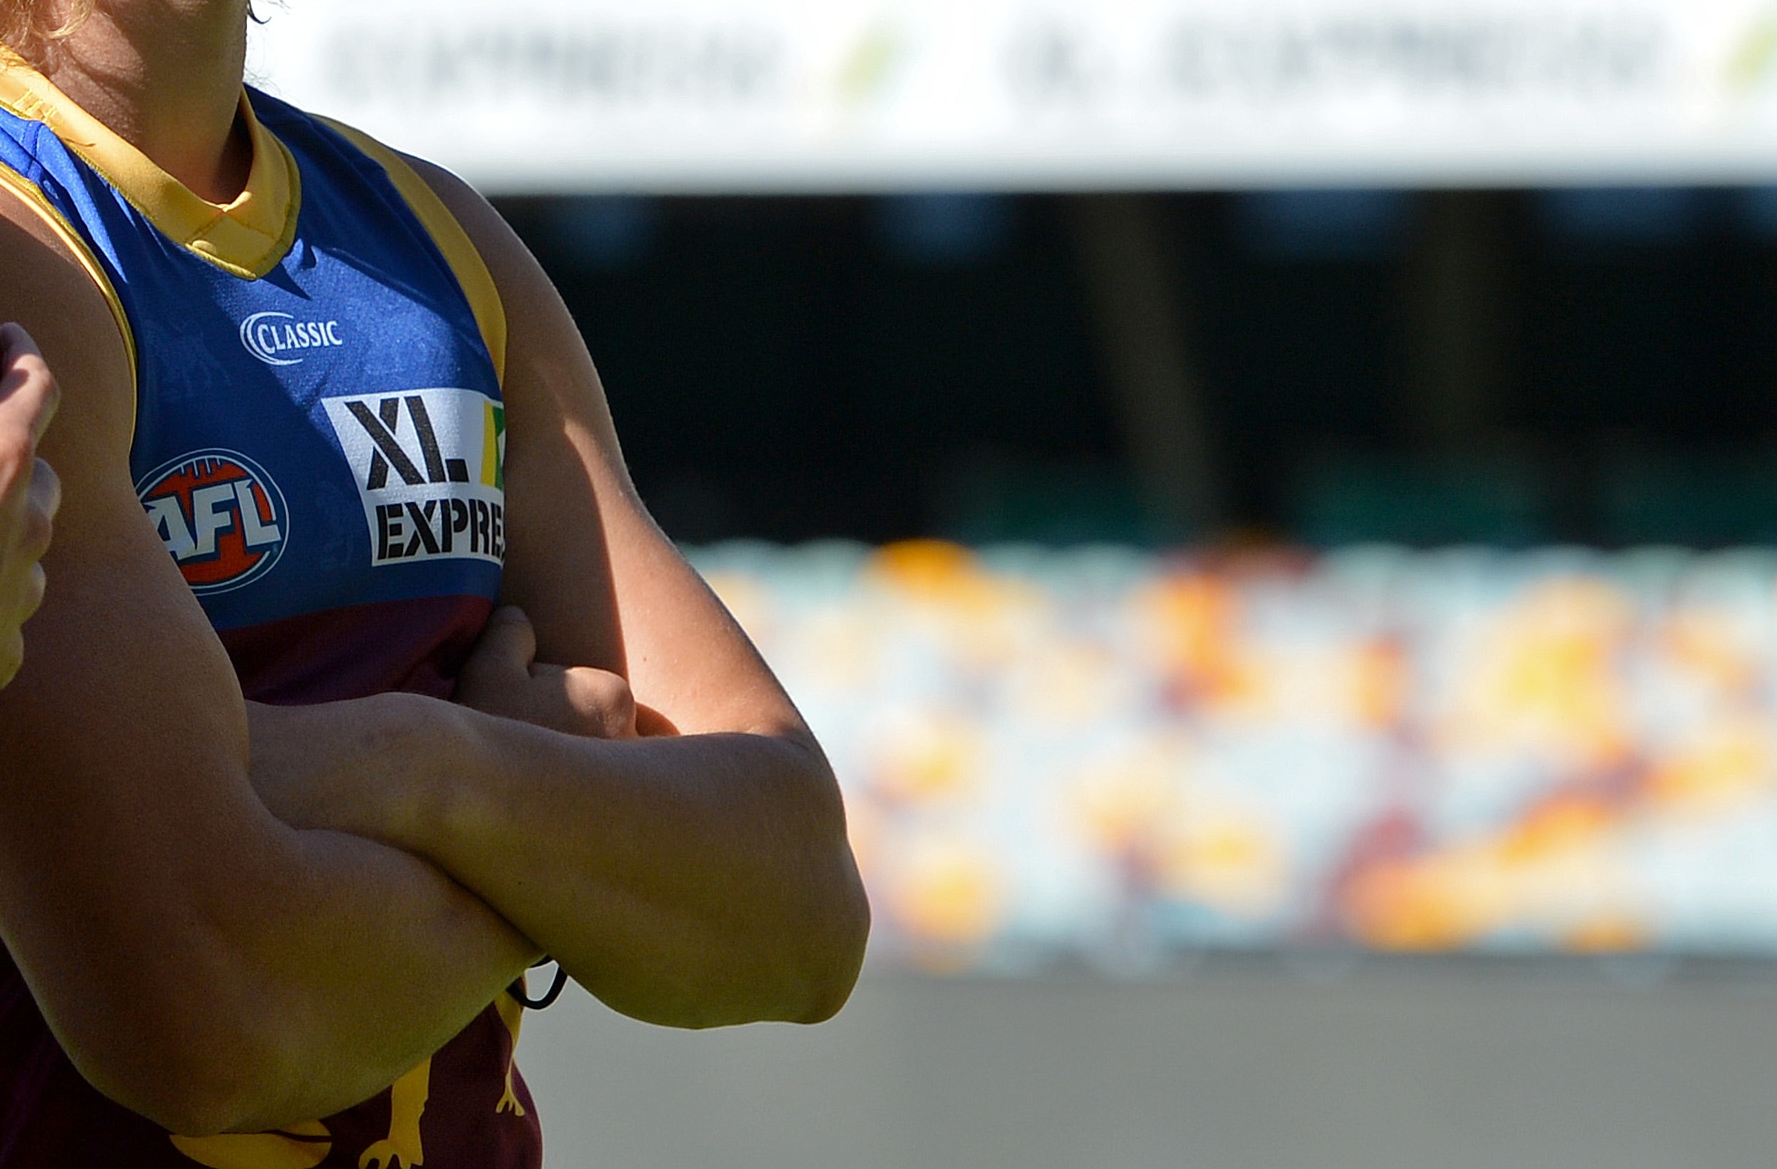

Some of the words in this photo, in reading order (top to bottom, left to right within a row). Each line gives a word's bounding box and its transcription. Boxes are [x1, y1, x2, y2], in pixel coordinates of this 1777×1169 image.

[257, 320, 344, 354] CLASSIC
[344, 395, 470, 491] XL
[142, 479, 282, 561] AFL
